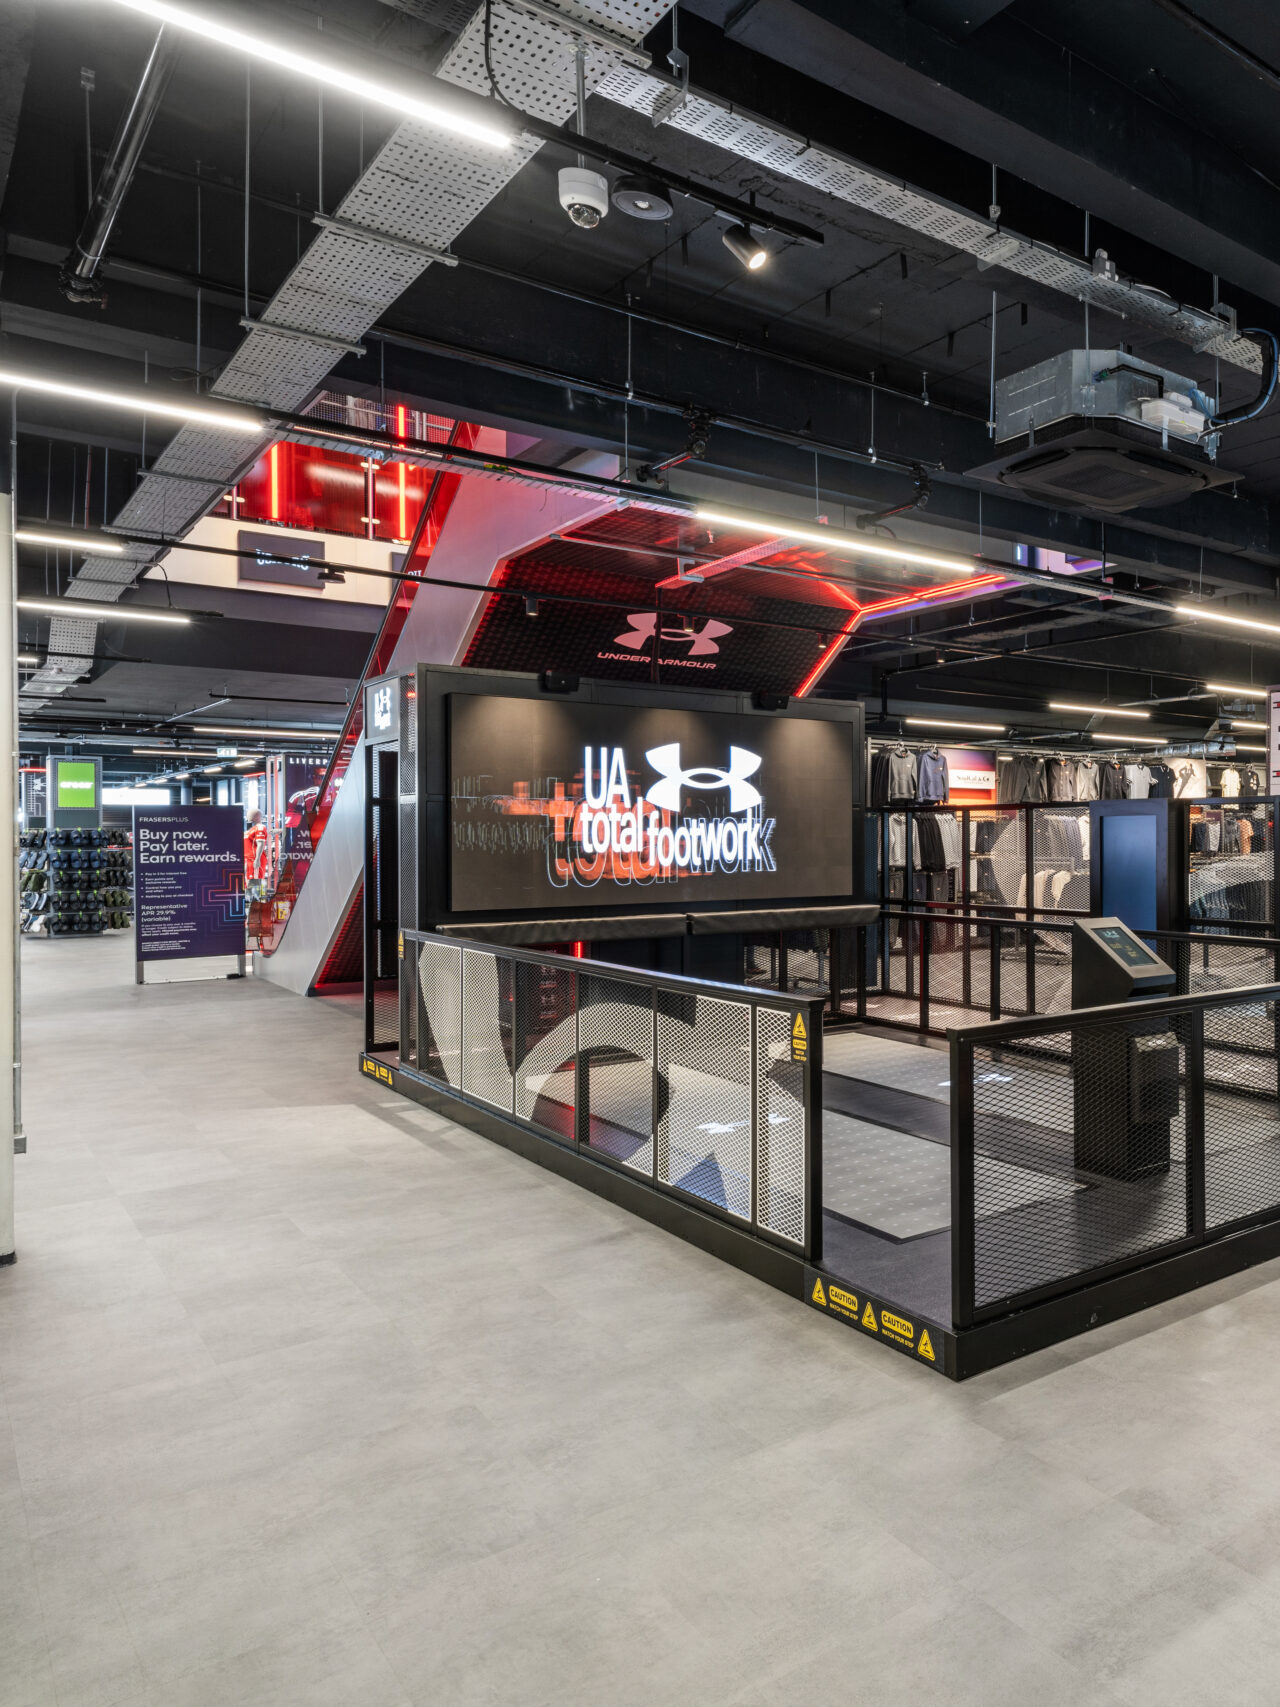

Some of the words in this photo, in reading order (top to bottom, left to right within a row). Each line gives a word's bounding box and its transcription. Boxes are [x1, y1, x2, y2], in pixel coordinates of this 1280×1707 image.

[597, 652, 651, 663] UNDER
[657, 658, 717, 670] ARMOUR
[584, 746, 631, 809] UA
[140, 829, 169, 842] Buy
[172, 831, 208, 840] now.
[580, 796, 643, 853] total
[647, 810, 762, 867] footwork
[140, 841, 169, 854] Pay
[173, 840, 210, 851] later.
[140, 852, 176, 864] Earn
[178, 851, 240, 862] rewards.
[830, 1289, 856, 1308] CAUTION
[882, 1314, 912, 1335] CAUTION
